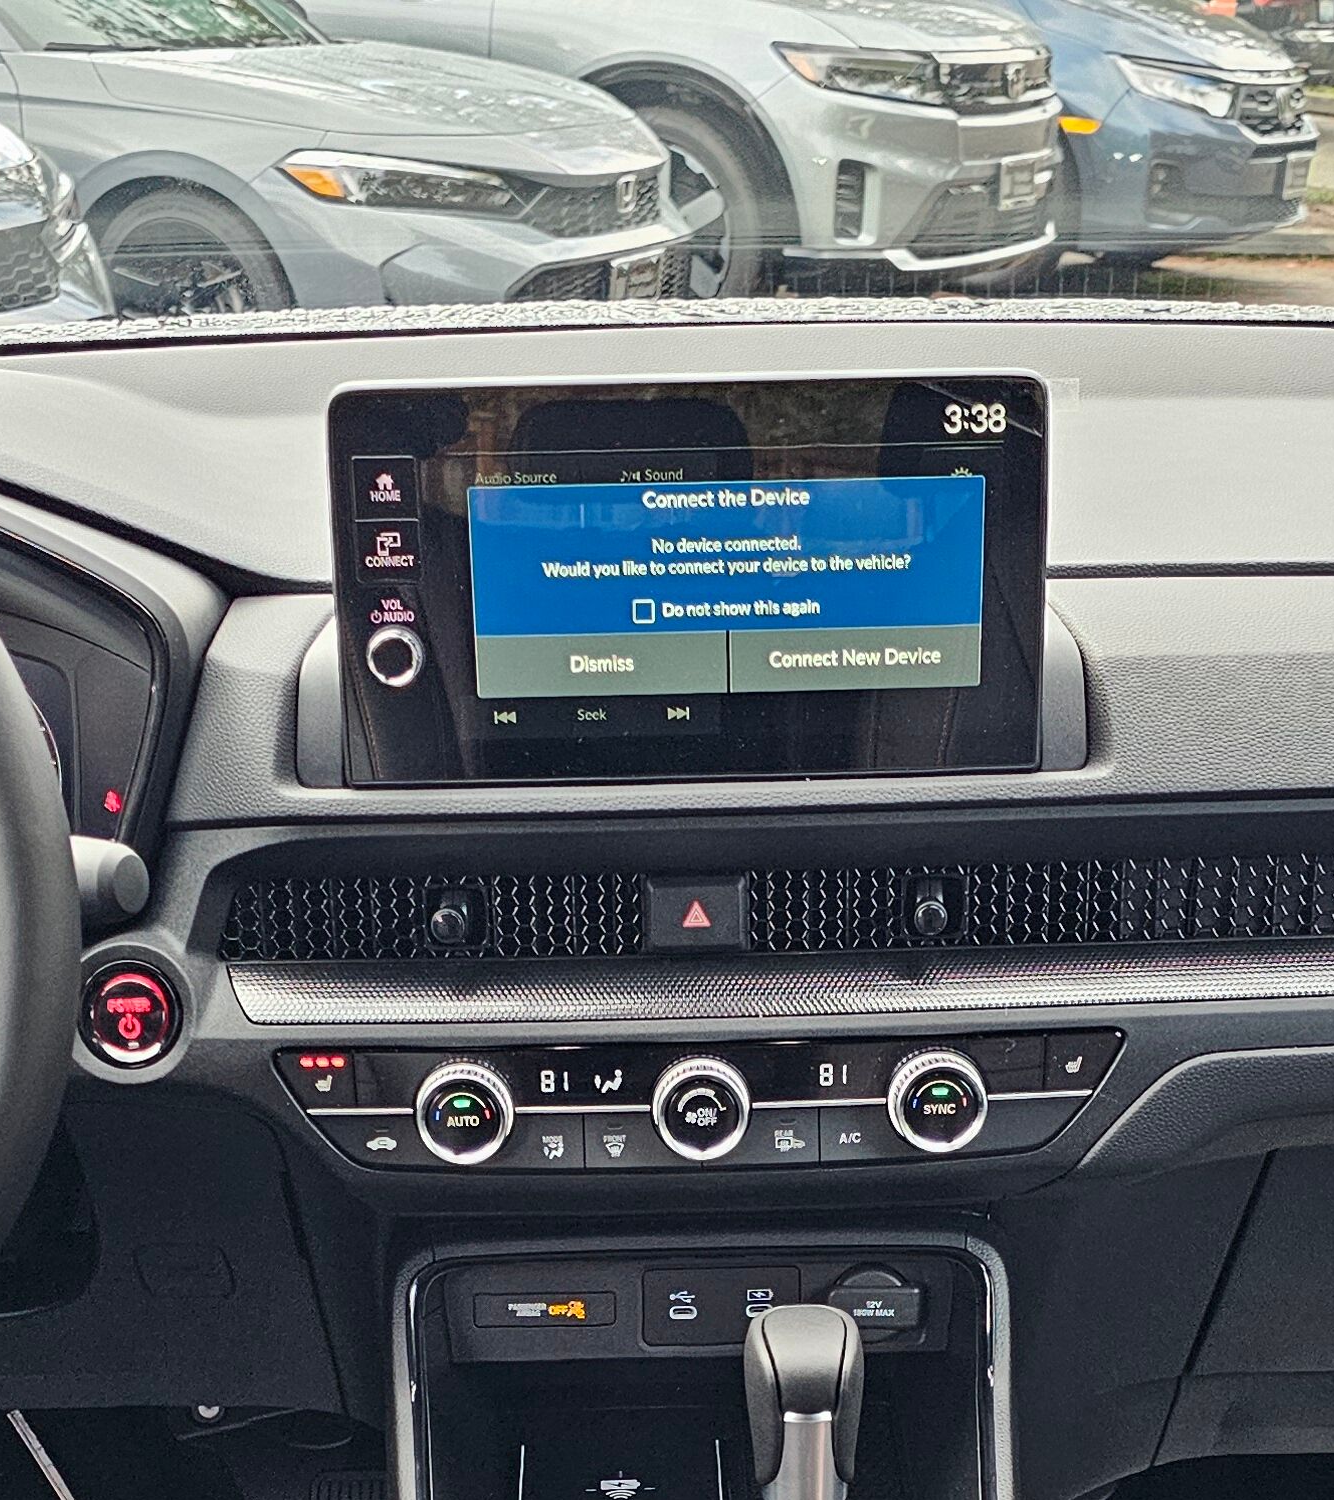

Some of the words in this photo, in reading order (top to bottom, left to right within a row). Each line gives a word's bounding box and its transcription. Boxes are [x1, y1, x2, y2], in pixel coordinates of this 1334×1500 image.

[943, 403, 1007, 434] 3:38
[474, 472, 512, 485] Audio
[513, 472, 558, 485] Source
[645, 468, 684, 482] Sound
[370, 490, 402, 502] HOME
[642, 491, 715, 509] Connect
[718, 489, 747, 507] the
[751, 488, 810, 507] Device
[651, 539, 674, 554] No
[677, 537, 722, 554] device
[724, 535, 802, 553] connected.
[365, 555, 415, 568] CONNECT
[541, 561, 590, 577] Would
[593, 563, 620, 580] you
[622, 560, 648, 576] like
[649, 560, 666, 575] to
[668, 560, 725, 575] connect
[727, 560, 761, 576] your
[763, 557, 808, 573] device
[810, 557, 827, 572] to
[829, 556, 854, 571] the
[855, 553, 912, 570] vehicle?
[381, 599, 404, 611] VOL
[662, 602, 684, 618] Do
[686, 602, 711, 617] not
[713, 601, 751, 616] show
[754, 600, 780, 615] this
[782, 599, 821, 617] again
[383, 611, 415, 623] AUDIO
[569, 654, 635, 674] Dismiss
[769, 650, 839, 668] Connect
[842, 649, 882, 666] New
[884, 647, 942, 665] Device
[577, 708, 608, 721] Seek
[107, 997, 151, 1013] POWER
[922, 1103, 957, 1116] SYNC
[446, 1116, 480, 1128] AUTO
[697, 1117, 718, 1127] OFF
[839, 1132, 863, 1145] A/C
[548, 1304, 568, 1315] OFF
[875, 1309, 895, 1317] MAX
